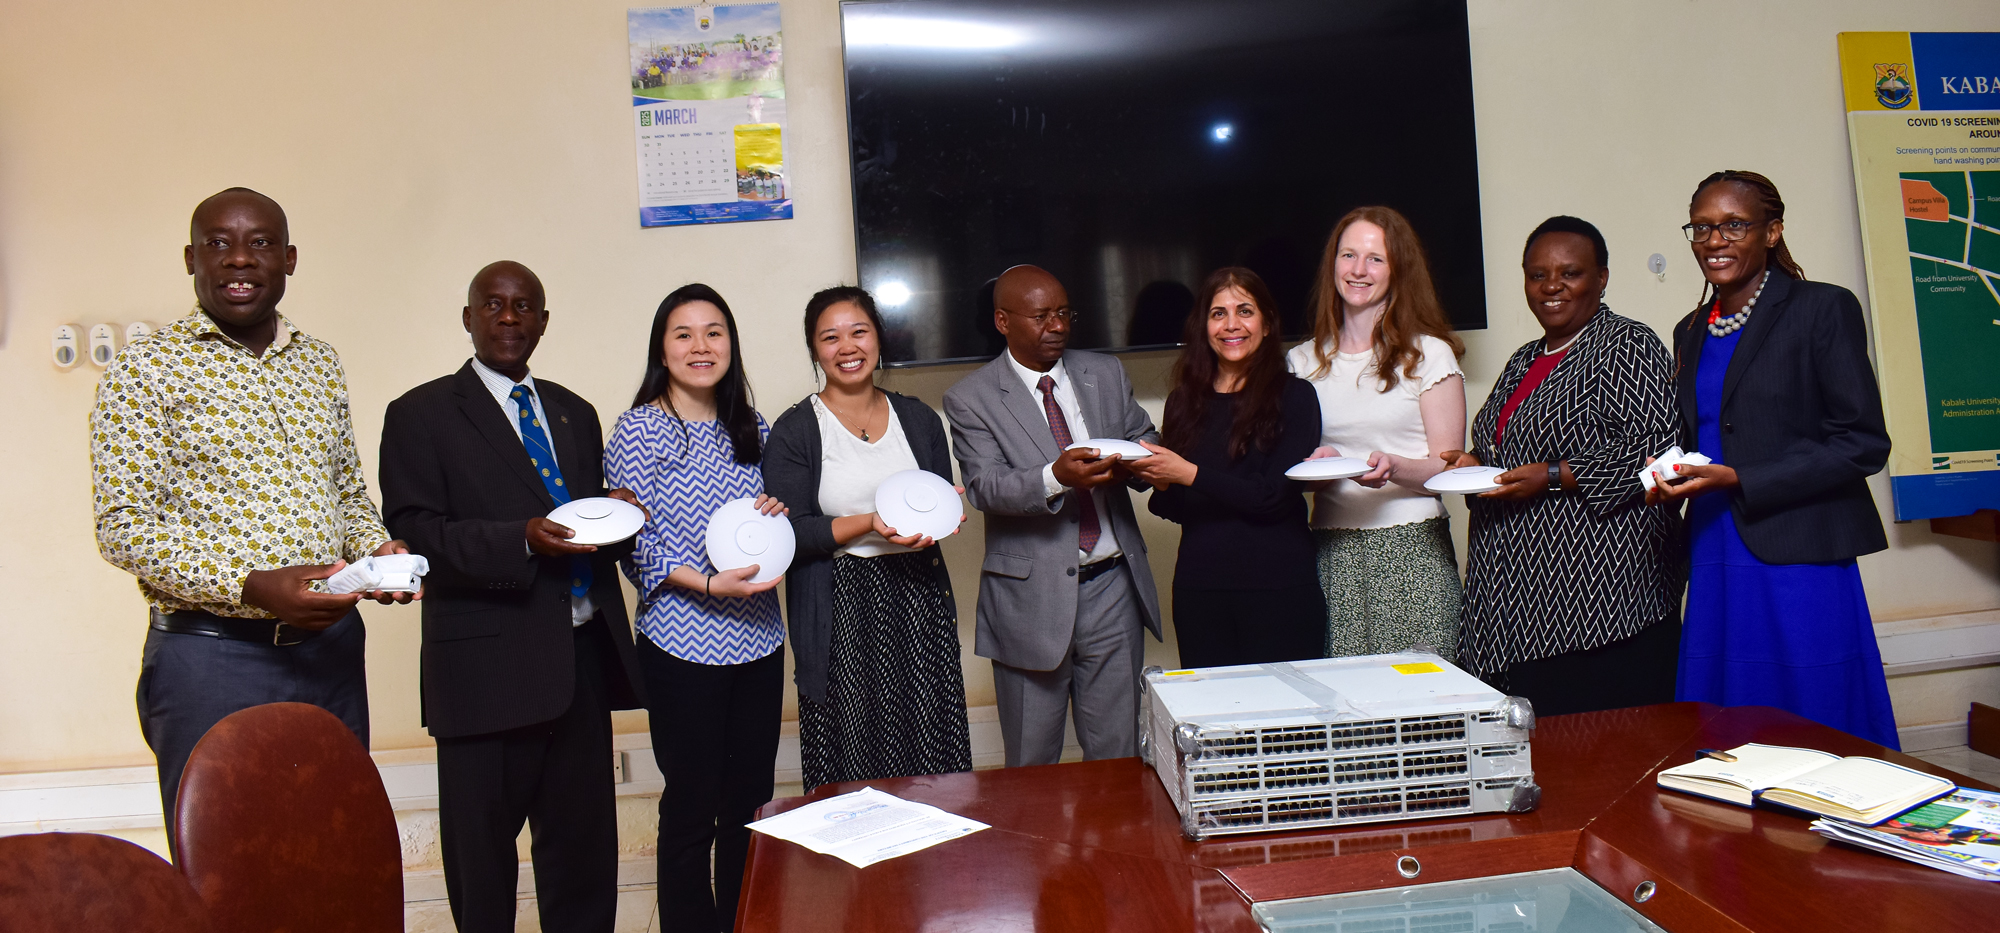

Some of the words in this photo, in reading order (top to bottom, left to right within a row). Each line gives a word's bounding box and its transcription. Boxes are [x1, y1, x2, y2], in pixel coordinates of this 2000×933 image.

[1941, 77, 2000, 94] KABA
[641, 111, 650, 125] 2025
[654, 108, 697, 126] MARCH
[1941, 118, 1951, 126] 19
[1896, 147, 1933, 155] Screening
[1936, 147, 1957, 155] points
[1954, 157, 1984, 165] washing
[1948, 274, 1978, 284] University
[1941, 399, 1965, 407] Kabale
[1967, 397, 2000, 406] University
[1943, 409, 1994, 417] Administration
